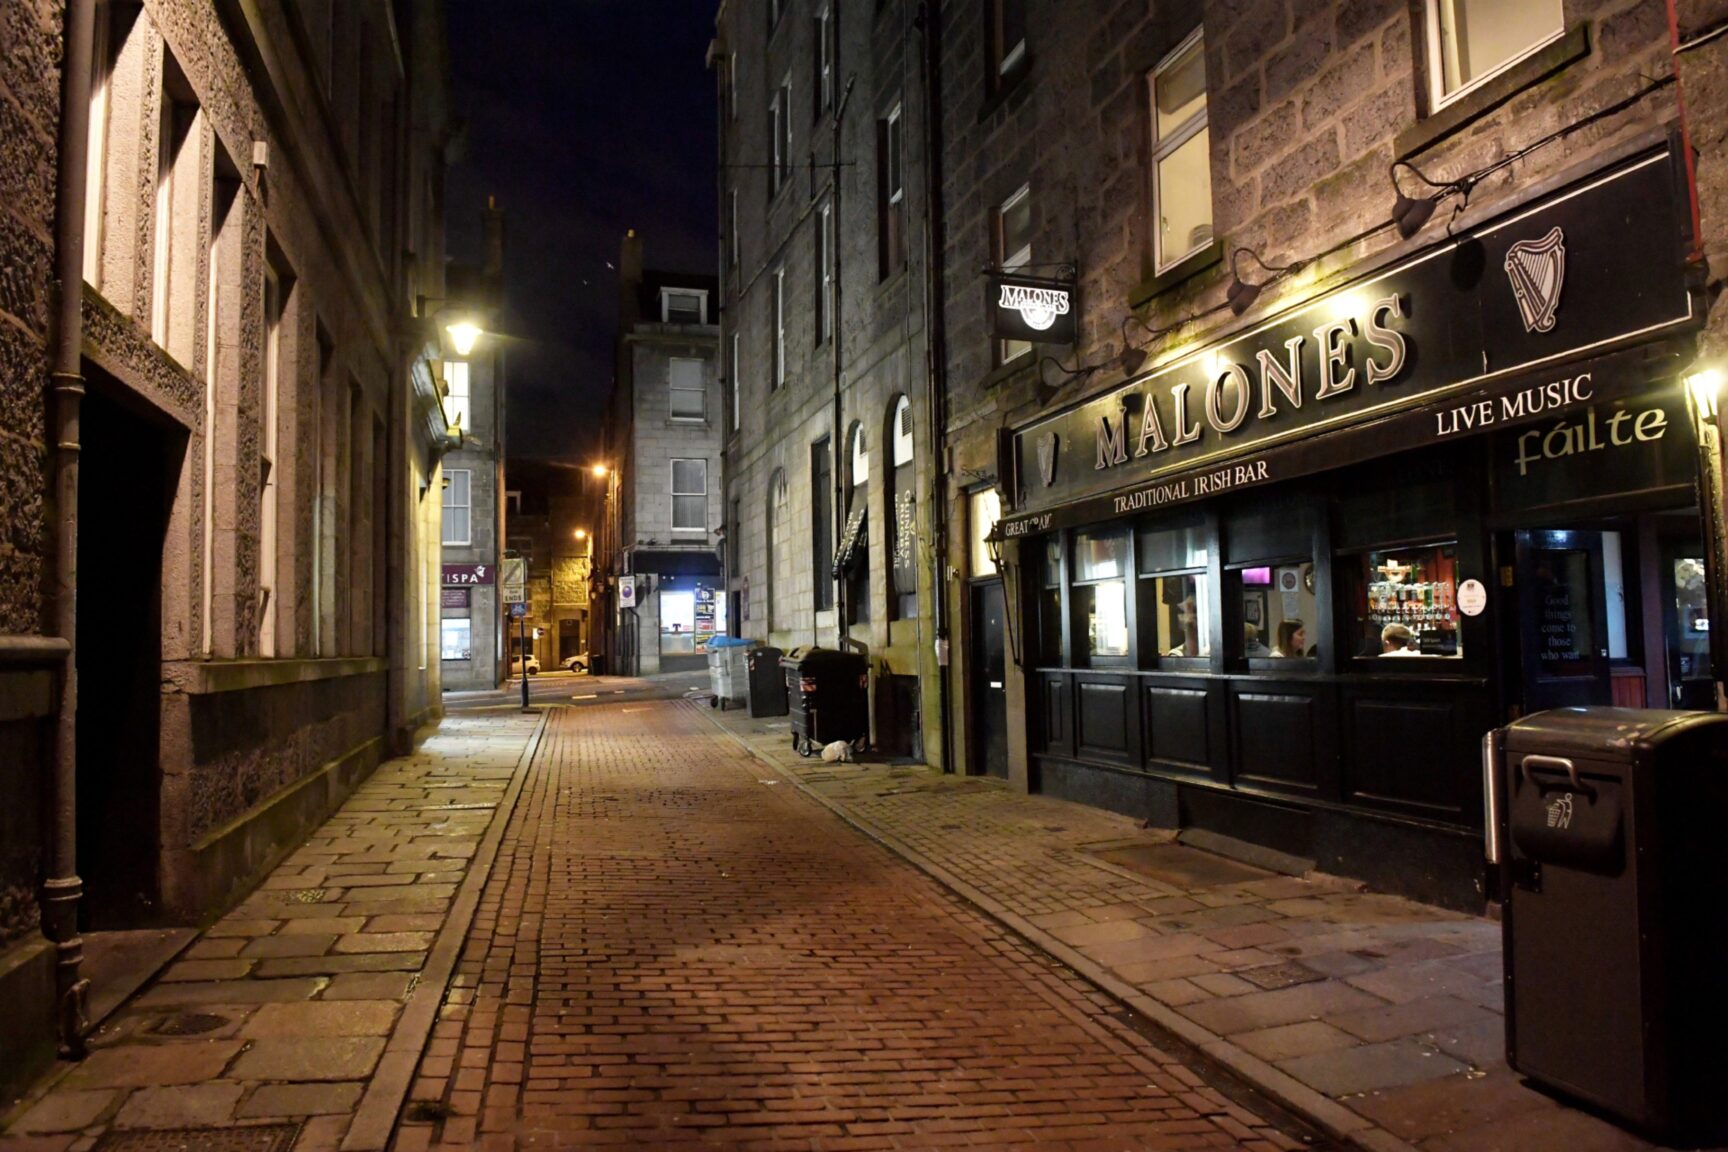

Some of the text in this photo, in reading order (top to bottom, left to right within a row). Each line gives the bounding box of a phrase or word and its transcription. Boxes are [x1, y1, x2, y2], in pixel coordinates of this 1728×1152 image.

[1001, 285, 1068, 313] MALONES
[1094, 293, 1406, 470] MALONES
[1435, 373, 1593, 436] LIVE MUSIC
[1113, 460, 1270, 513] TRADITIONAL IRISH BAR
[1005, 519, 1029, 537] GREAT
[442, 573, 479, 583] ISPA
[504, 594, 522, 602] ENDS
[1548, 635, 1571, 646] those
